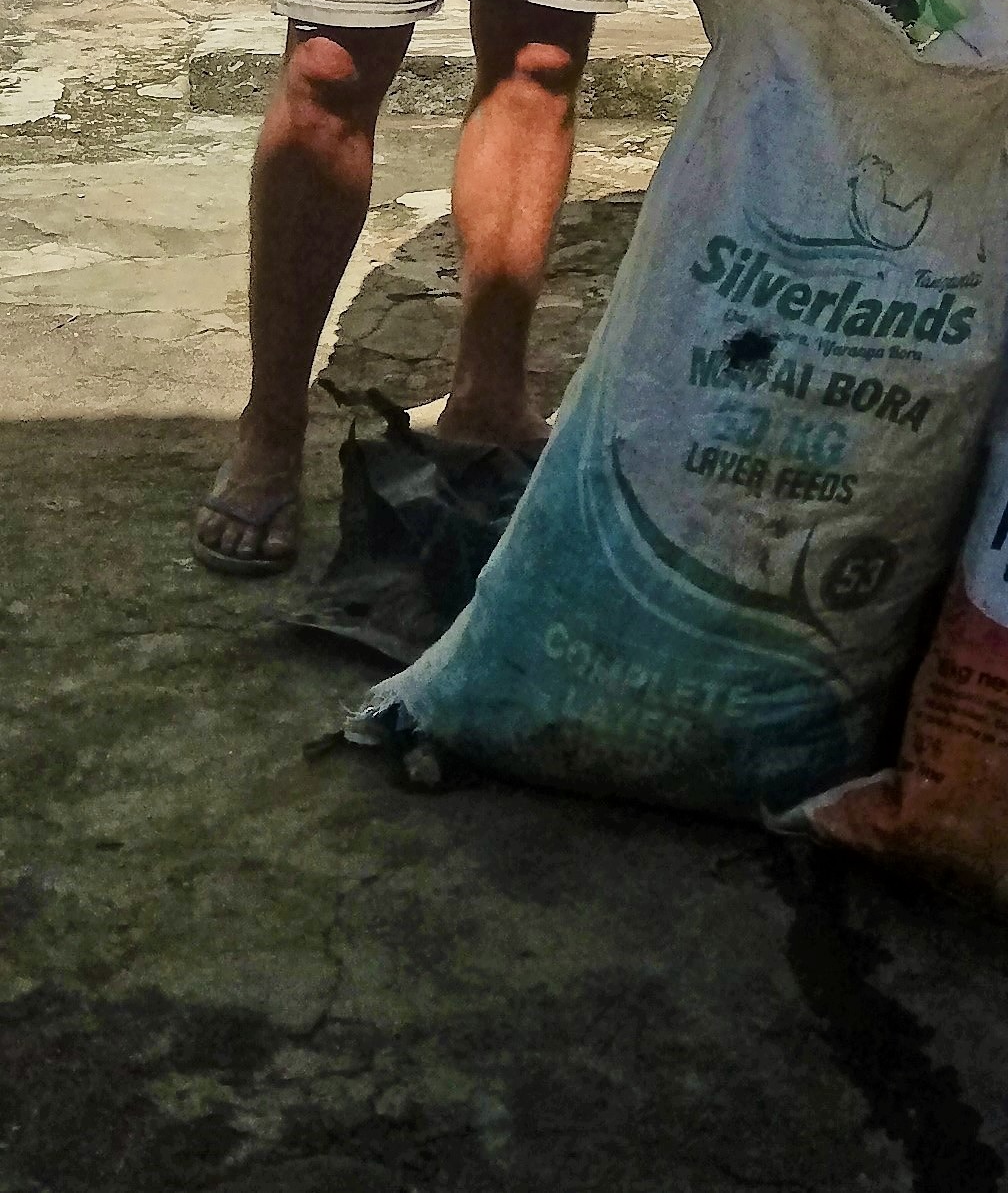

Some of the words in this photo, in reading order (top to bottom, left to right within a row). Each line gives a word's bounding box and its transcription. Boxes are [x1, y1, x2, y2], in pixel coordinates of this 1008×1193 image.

[688, 234, 978, 346] Silverlands
[821, 372, 934, 434] BORA
[684, 440, 770, 499] LAYER
[774, 465, 859, 505] FEEDS
